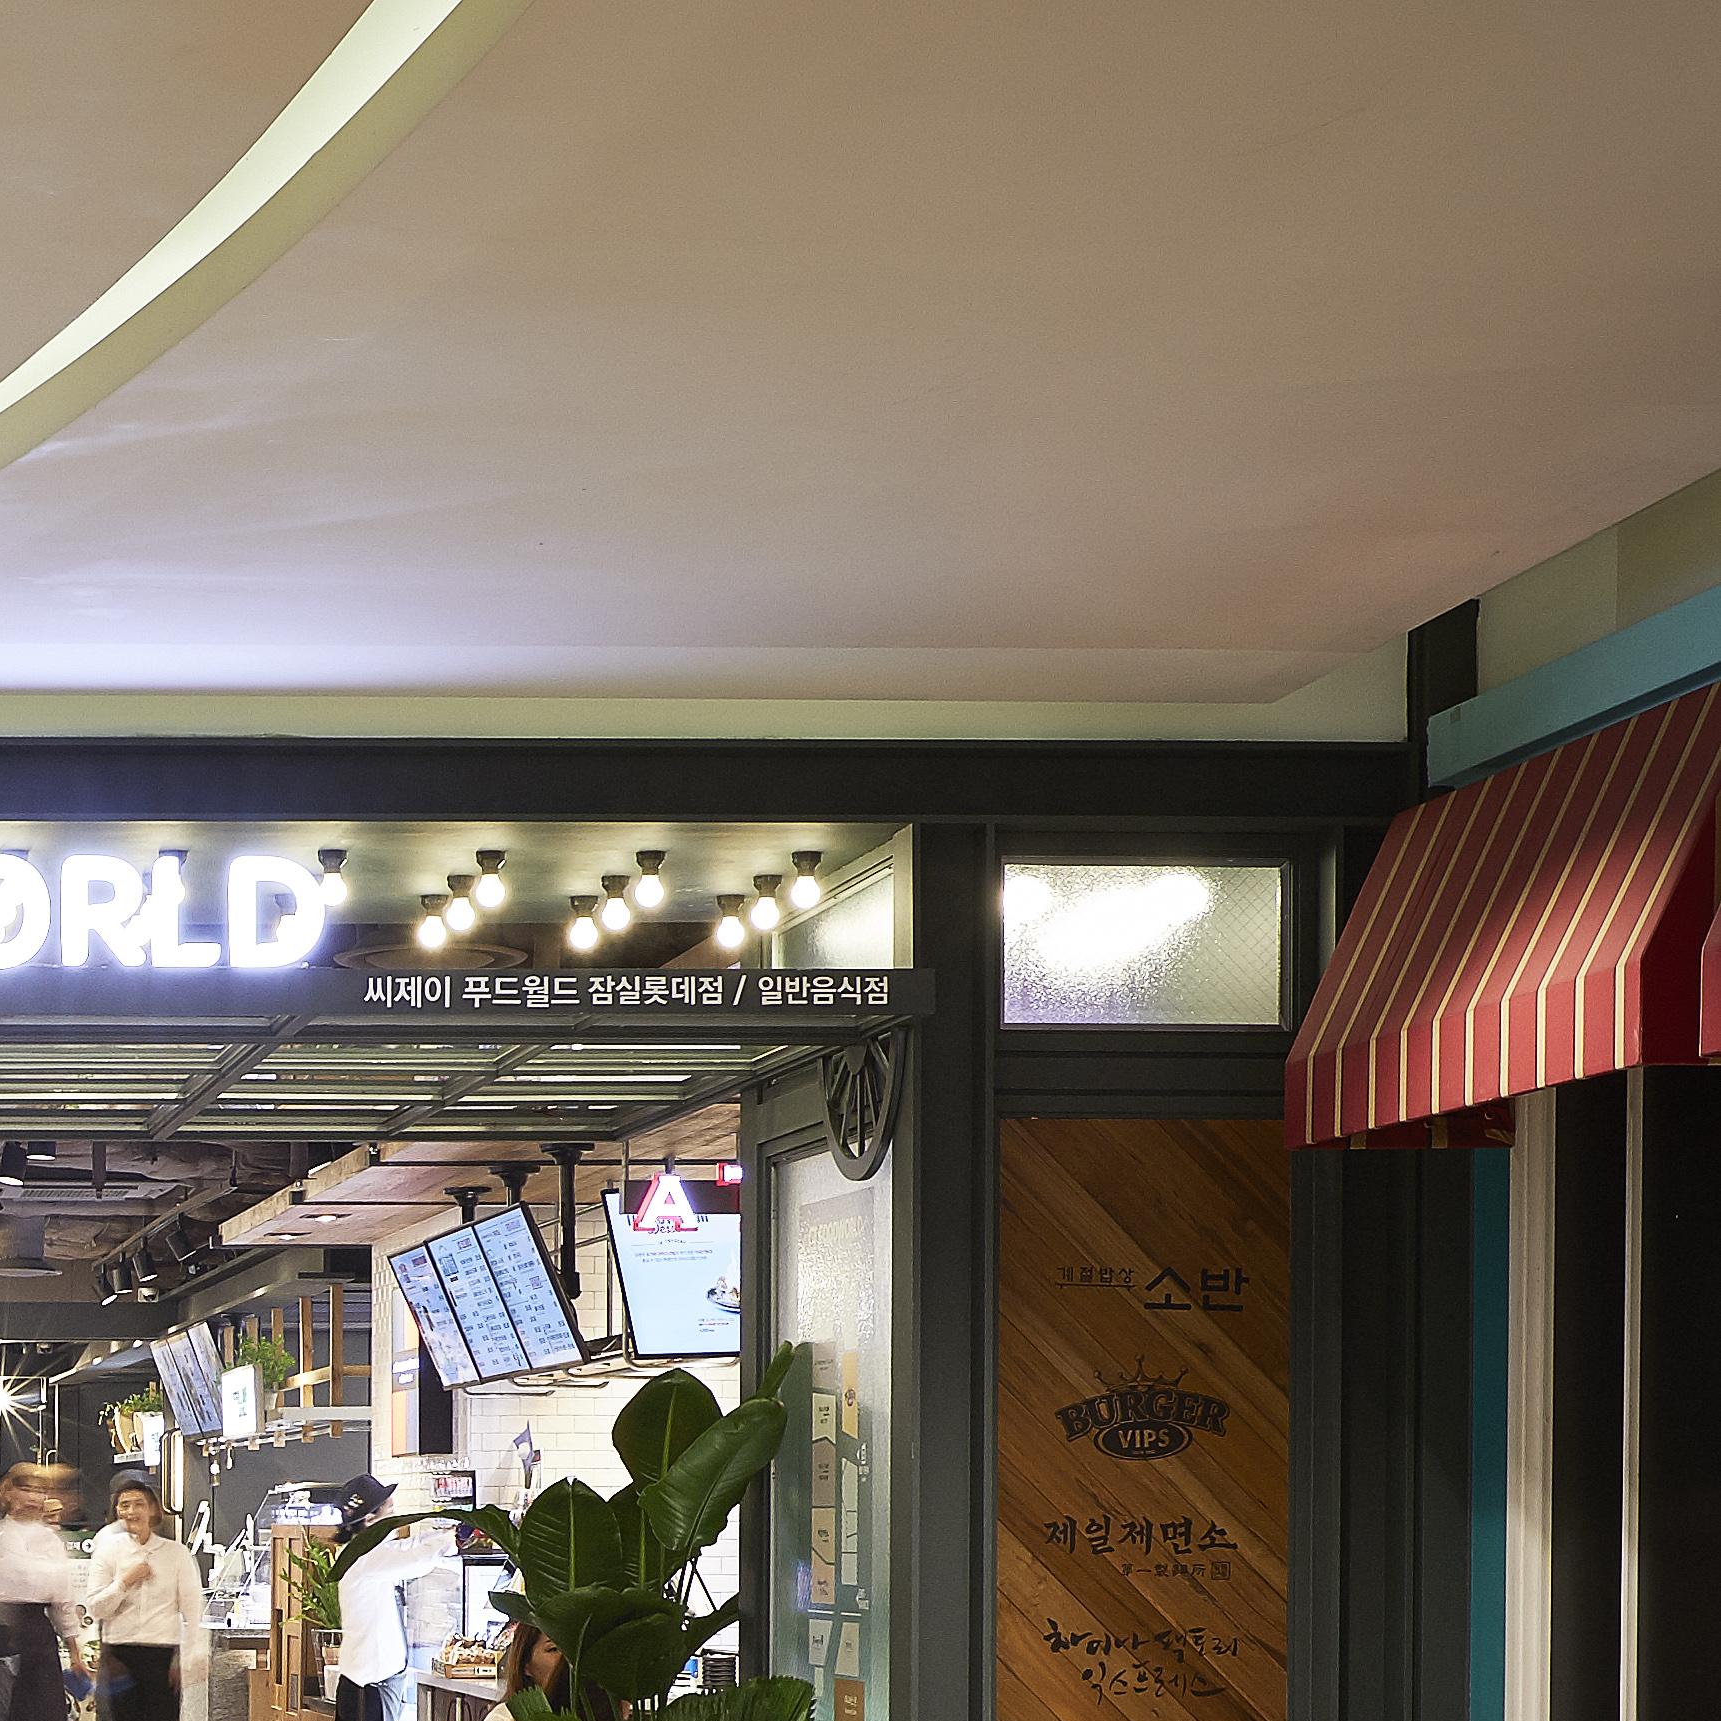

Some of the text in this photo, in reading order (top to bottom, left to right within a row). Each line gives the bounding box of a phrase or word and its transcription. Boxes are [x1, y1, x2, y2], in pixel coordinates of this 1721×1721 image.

[364, 975, 451, 1008] 씨제이
[461, 975, 581, 1008] 푸드월드
[587, 975, 723, 1006] 잠실롯데점
[758, 975, 888, 1006] 일반음식점
[1057, 1266, 1250, 1312] 계절밥상 소반
[1055, 1390, 1231, 1442] BURGER
[1118, 1428, 1171, 1449] VIPS
[1043, 1515, 1239, 1556] 제일제면소
[1043, 1617, 1238, 1663] 차이나 팩토리
[1082, 1661, 1227, 1705] 익스프레스
